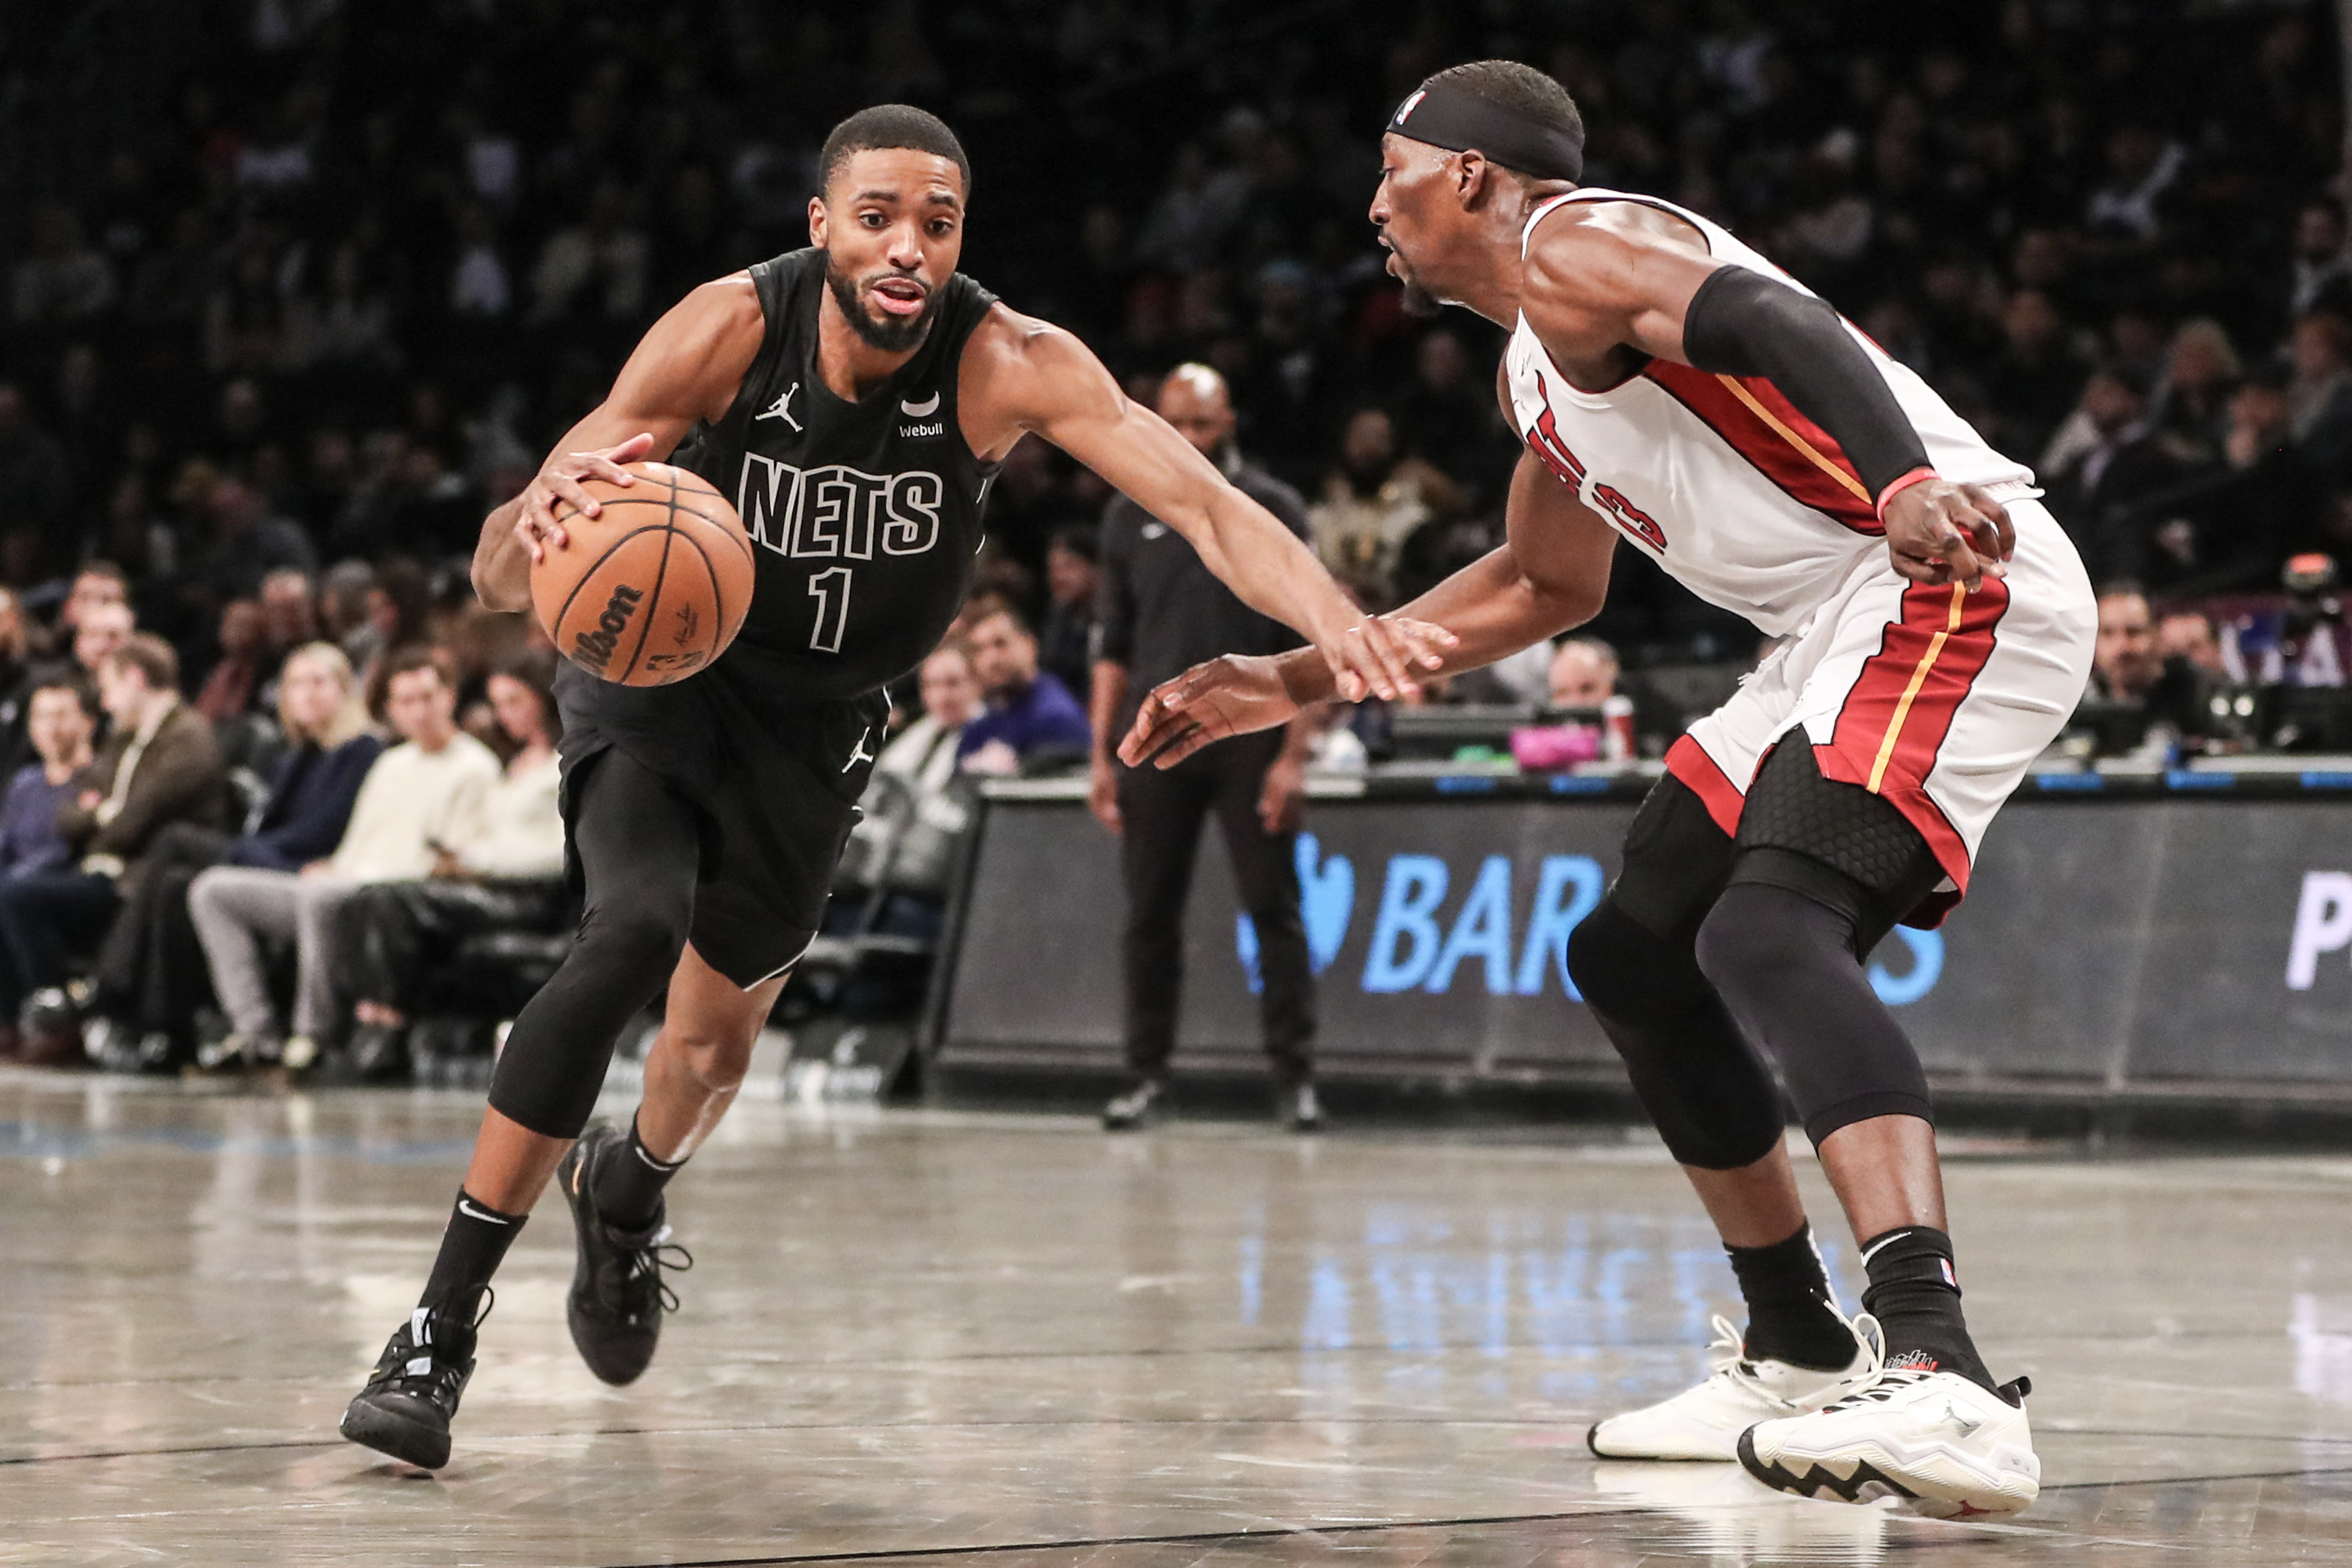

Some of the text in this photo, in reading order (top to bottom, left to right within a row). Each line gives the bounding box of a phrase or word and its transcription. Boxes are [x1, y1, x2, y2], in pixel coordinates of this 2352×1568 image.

[899, 422, 943, 437] Webull
[737, 451, 943, 561] NETS
[808, 566, 853, 653] 1
